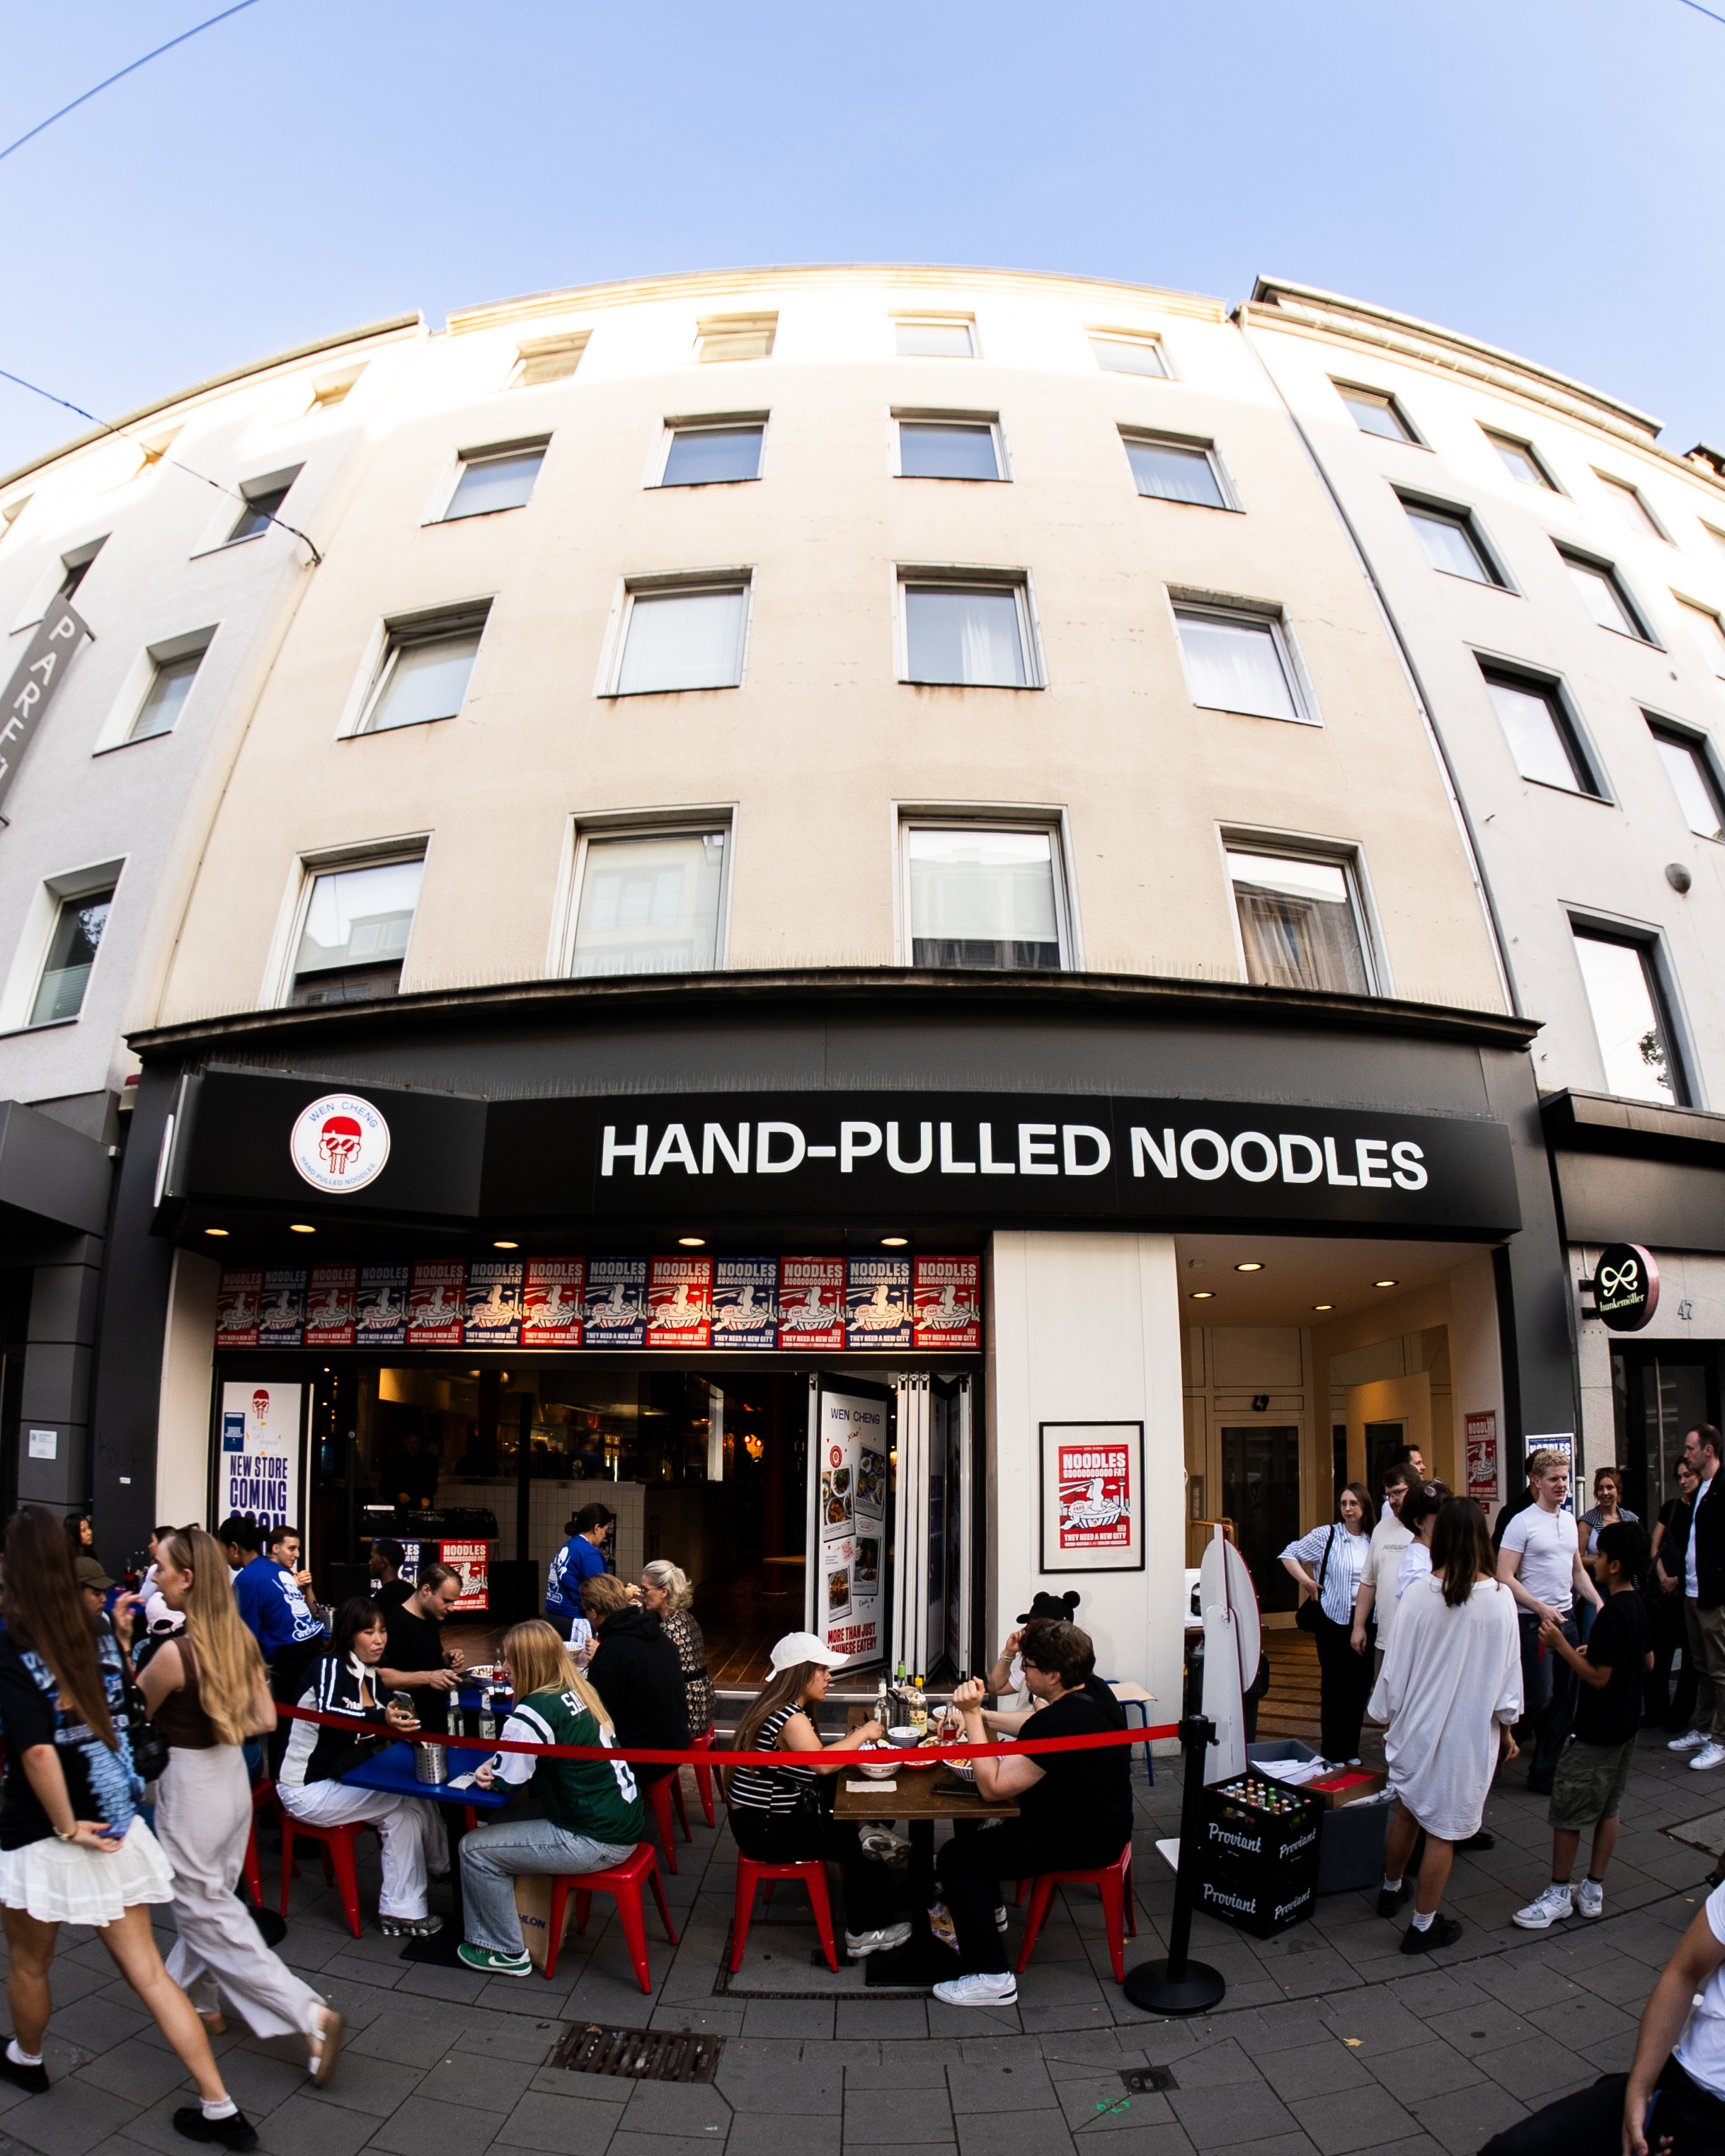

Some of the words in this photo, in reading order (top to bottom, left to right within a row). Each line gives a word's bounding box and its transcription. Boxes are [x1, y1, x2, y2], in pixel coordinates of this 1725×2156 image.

[309, 1103, 335, 1122] WEN
[341, 1101, 378, 1128] CHENG
[601, 1121, 1111, 1176] HAND-PULLED
[1130, 1127, 1428, 1191] NOODLES
[301, 1156, 316, 1176] HAND
[315, 1174, 343, 1186] PULLED
[345, 1163, 376, 1185] NOODLES
[265, 1271, 306, 1283] NOODLES
[313, 1268, 356, 1281] NOODLES
[362, 1267, 408, 1280] NOODLES
[416, 1266, 463, 1278] NOODLES
[471, 1264, 522, 1276] NOODLES
[530, 1264, 583, 1276] NOODLES
[590, 1263, 646, 1275] NOODLES
[654, 1263, 710, 1275] NOODLES
[718, 1263, 776, 1277] NOODLES
[785, 1264, 842, 1278] NOODLES
[851, 1263, 910, 1276] NOODLES
[919, 1263, 976, 1277] NOODLES
[223, 1273, 262, 1285] NOODLES
[1600, 1292, 1645, 1312] hunkemöller
[1678, 1300, 1695, 1319] 47
[831, 1408, 849, 1421] WEN
[854, 1411, 880, 1424] CHENG
[230, 1455, 252, 1476] NEW
[255, 1457, 288, 1479] STORE
[1063, 1452, 1125, 1469] NOODLES
[229, 1478, 287, 1512] COMING
[444, 1545, 486, 1555] NOODLES
[827, 1628, 844, 1645] MORE
[845, 1624, 861, 1641] THAN
[861, 1622, 876, 1638] JUST
[856, 1636, 878, 1653] EATERY
[1209, 1823, 1261, 1853] Proviant
[1280, 1828, 1317, 1859] Proviant
[1203, 1883, 1256, 1914] Proviant
[1274, 1887, 1310, 1920] Proviant
